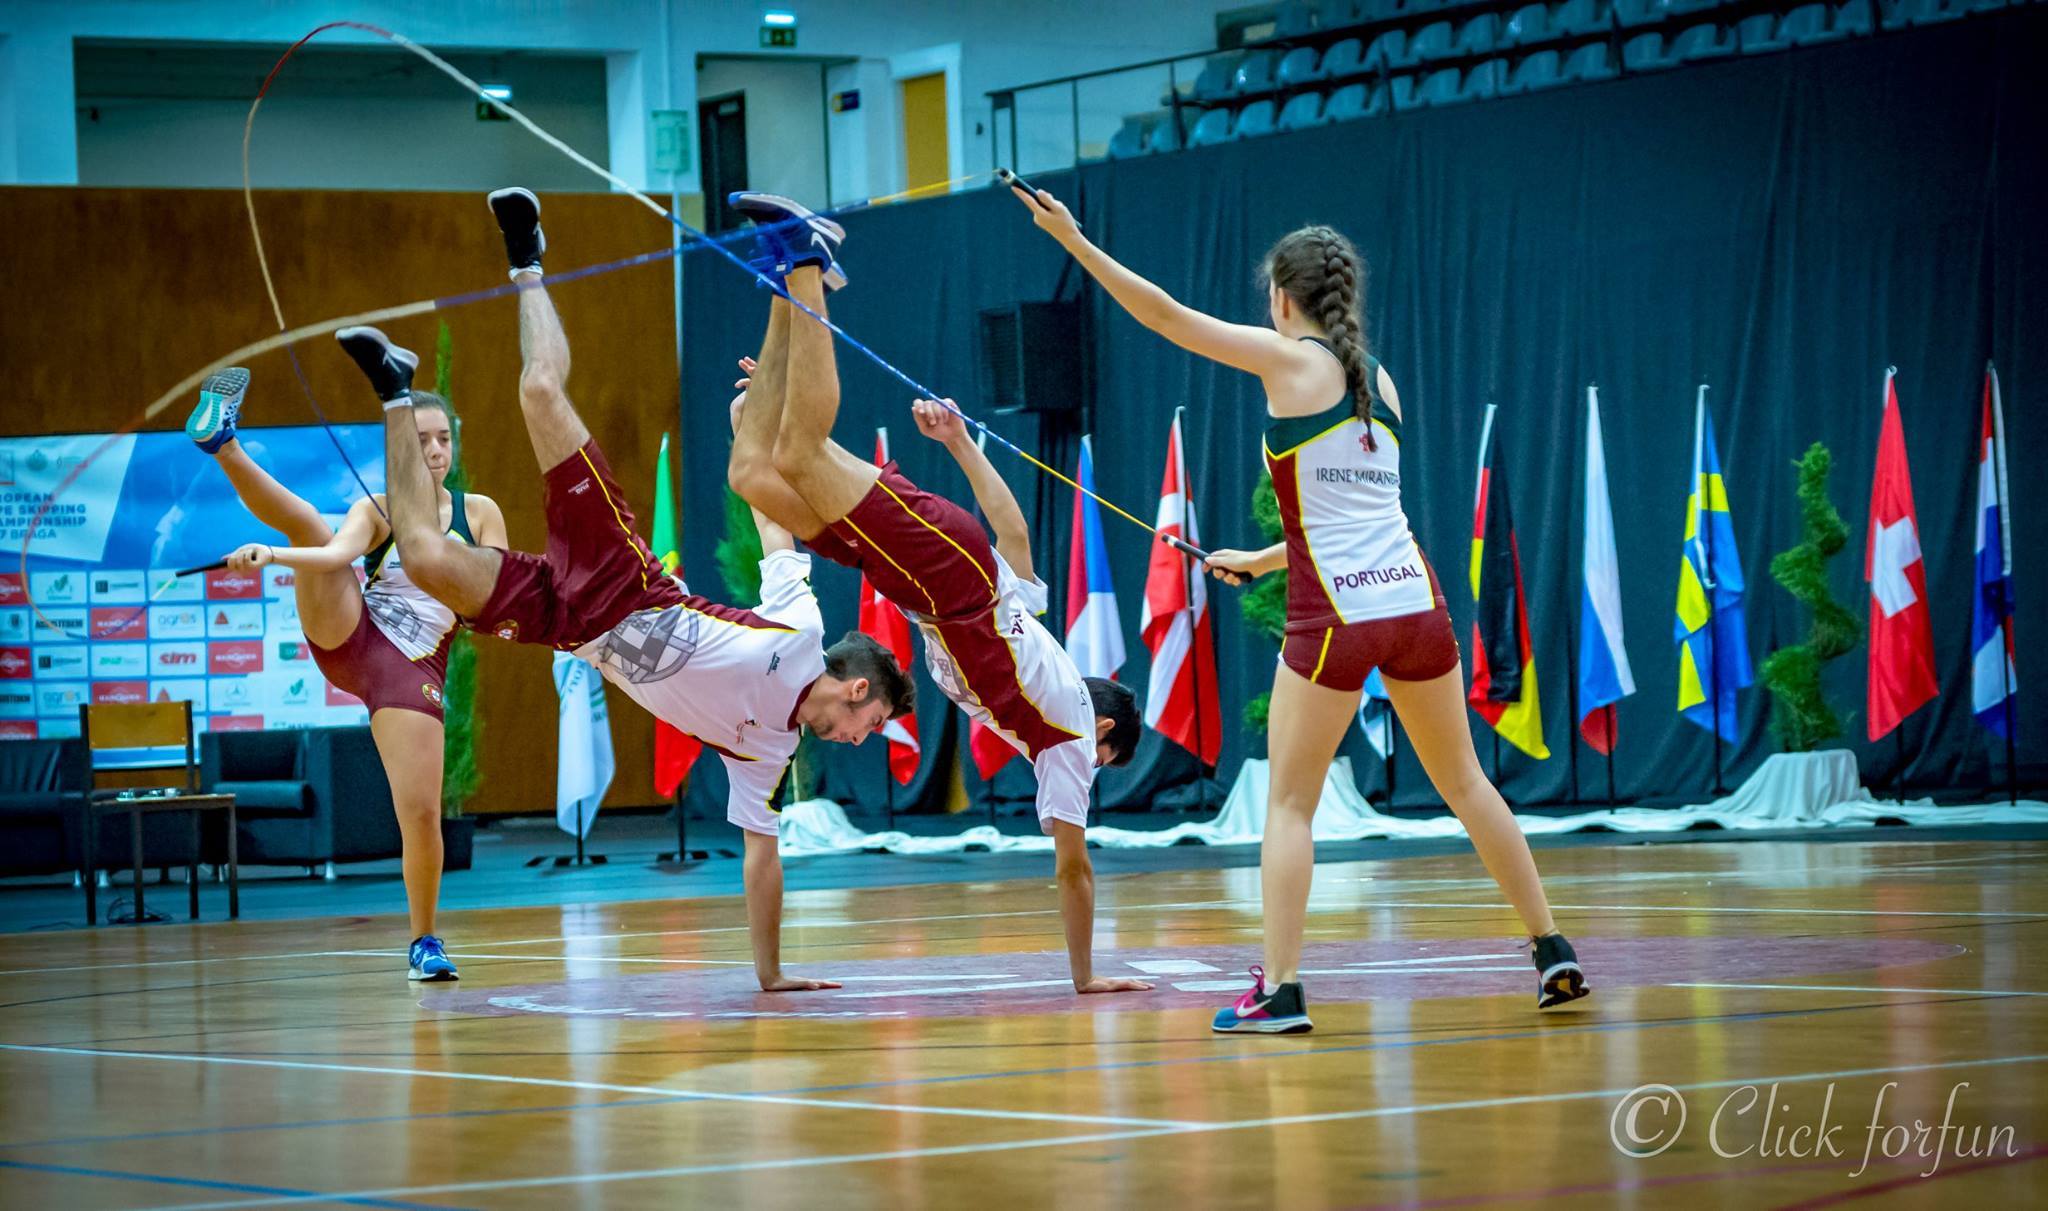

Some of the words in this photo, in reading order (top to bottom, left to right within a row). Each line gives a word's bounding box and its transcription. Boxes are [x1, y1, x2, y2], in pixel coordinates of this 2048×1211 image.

[1316, 467, 1352, 483] IRENE
[19, 503, 86, 515] SKIPPING
[10, 528, 57, 540] BRAGA
[1333, 564, 1422, 592] PORTUGAL
[160, 652, 196, 664] sim
